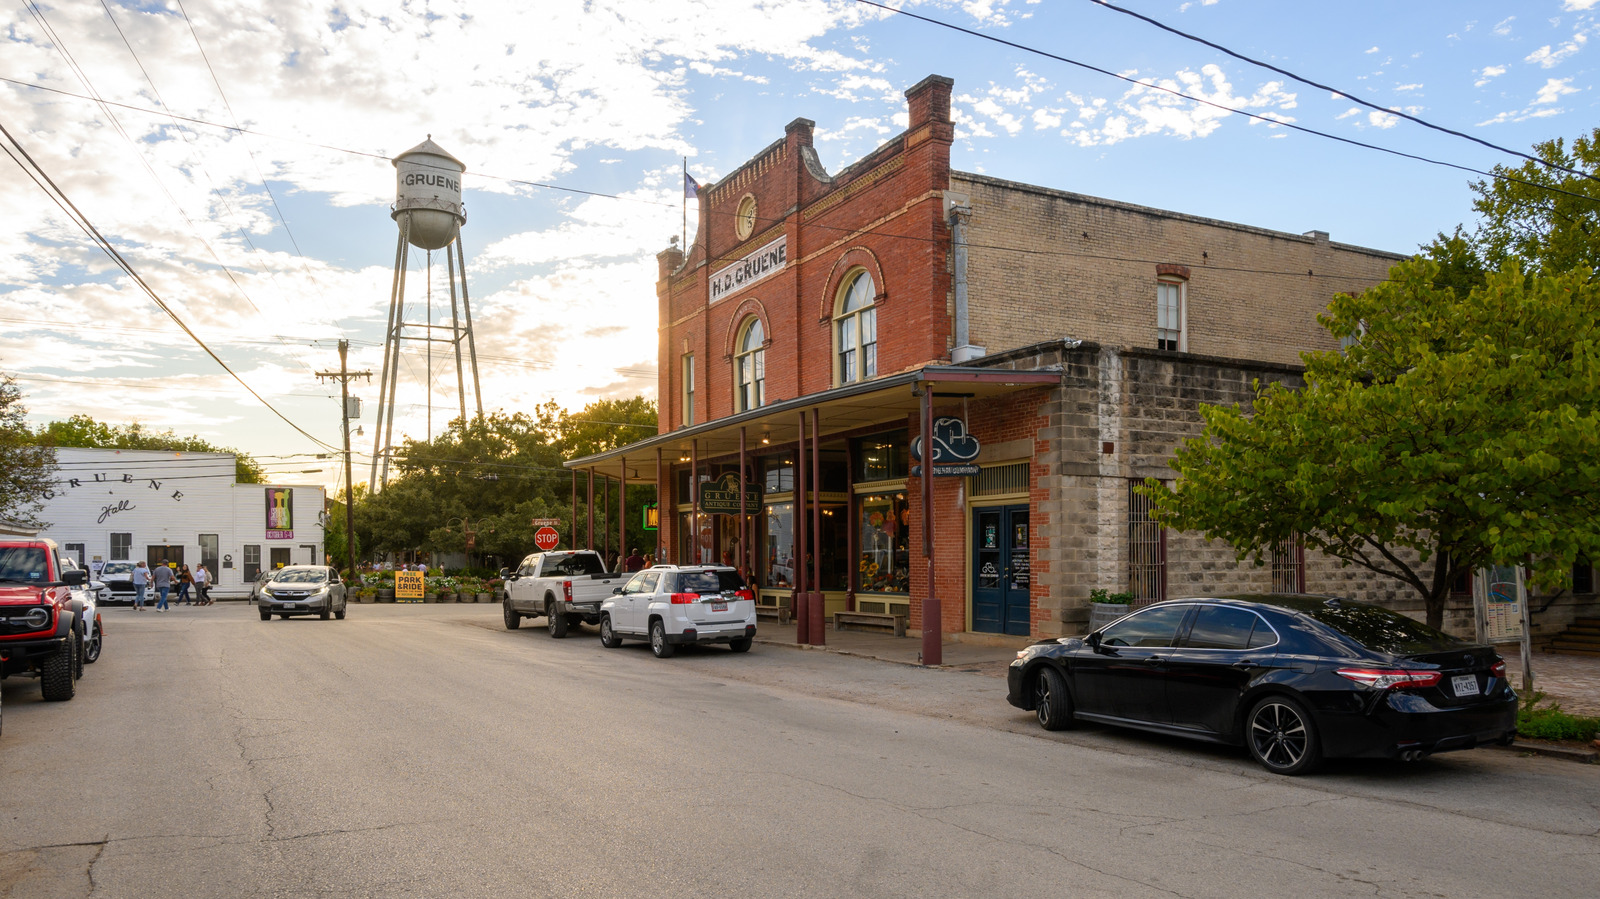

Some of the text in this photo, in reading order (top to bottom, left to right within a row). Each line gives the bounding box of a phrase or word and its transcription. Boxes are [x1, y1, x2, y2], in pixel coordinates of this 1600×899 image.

[405, 173, 459, 193] GRUENE
[42, 472, 184, 502] GRUENE
[704, 492, 759, 501] GRUENE
[97, 499, 136, 524] Hall
[536, 533, 557, 543] STOP
[398, 576, 422, 584] PARK
